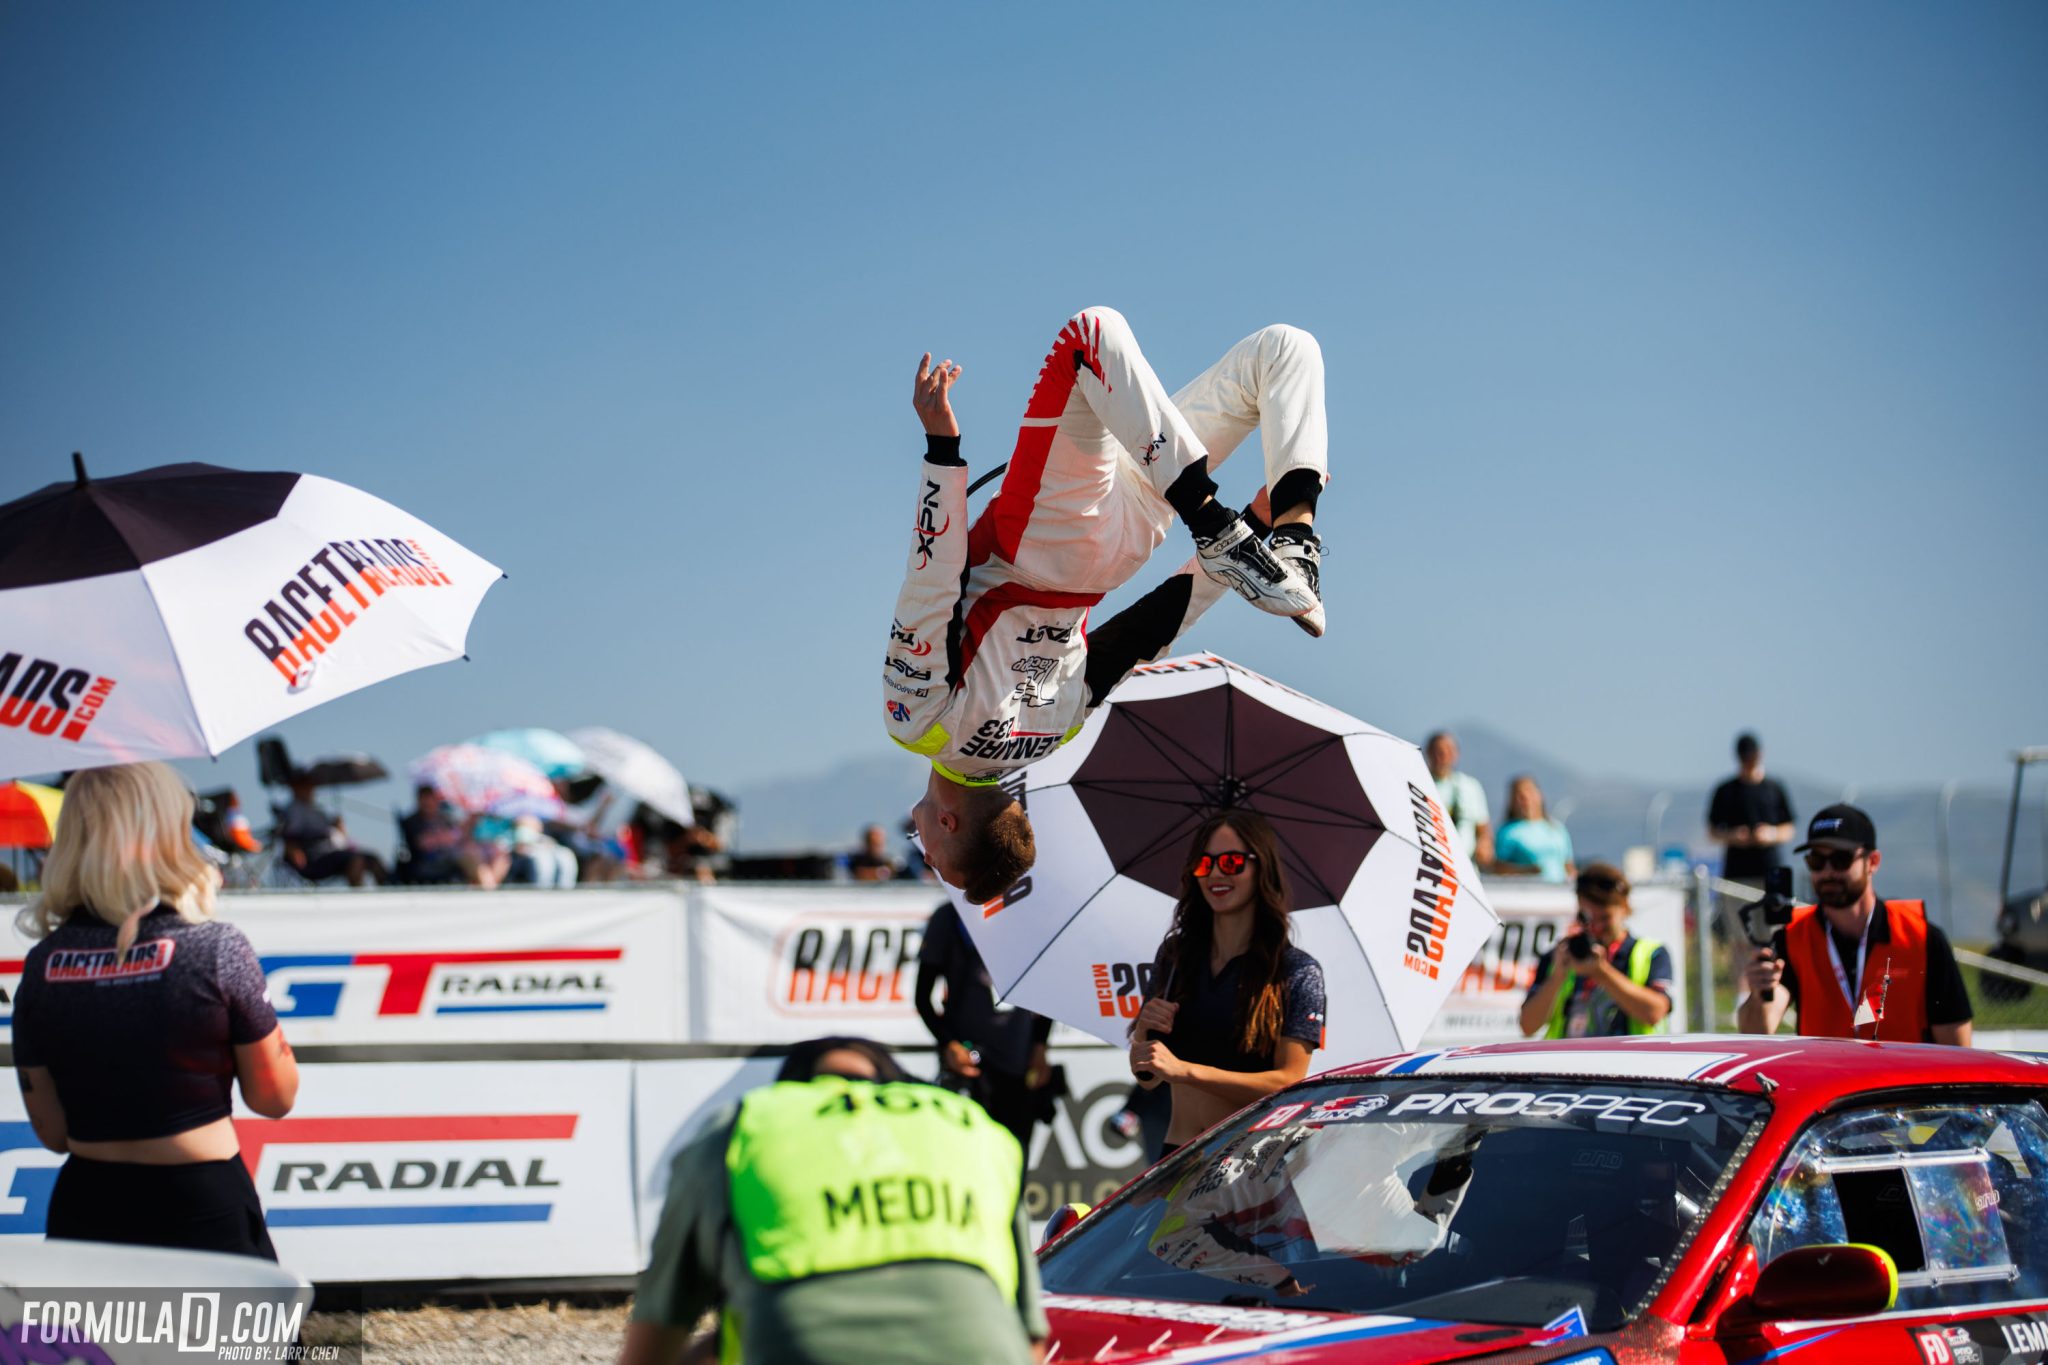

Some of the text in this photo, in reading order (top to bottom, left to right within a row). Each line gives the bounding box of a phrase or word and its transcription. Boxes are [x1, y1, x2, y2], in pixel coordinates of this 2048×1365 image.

[441, 972, 615, 996] RADIAL
[1388, 1092, 1706, 1127] PROSPEC
[272, 1158, 563, 1192] RADIAL
[823, 1174, 981, 1230] MEDIA
